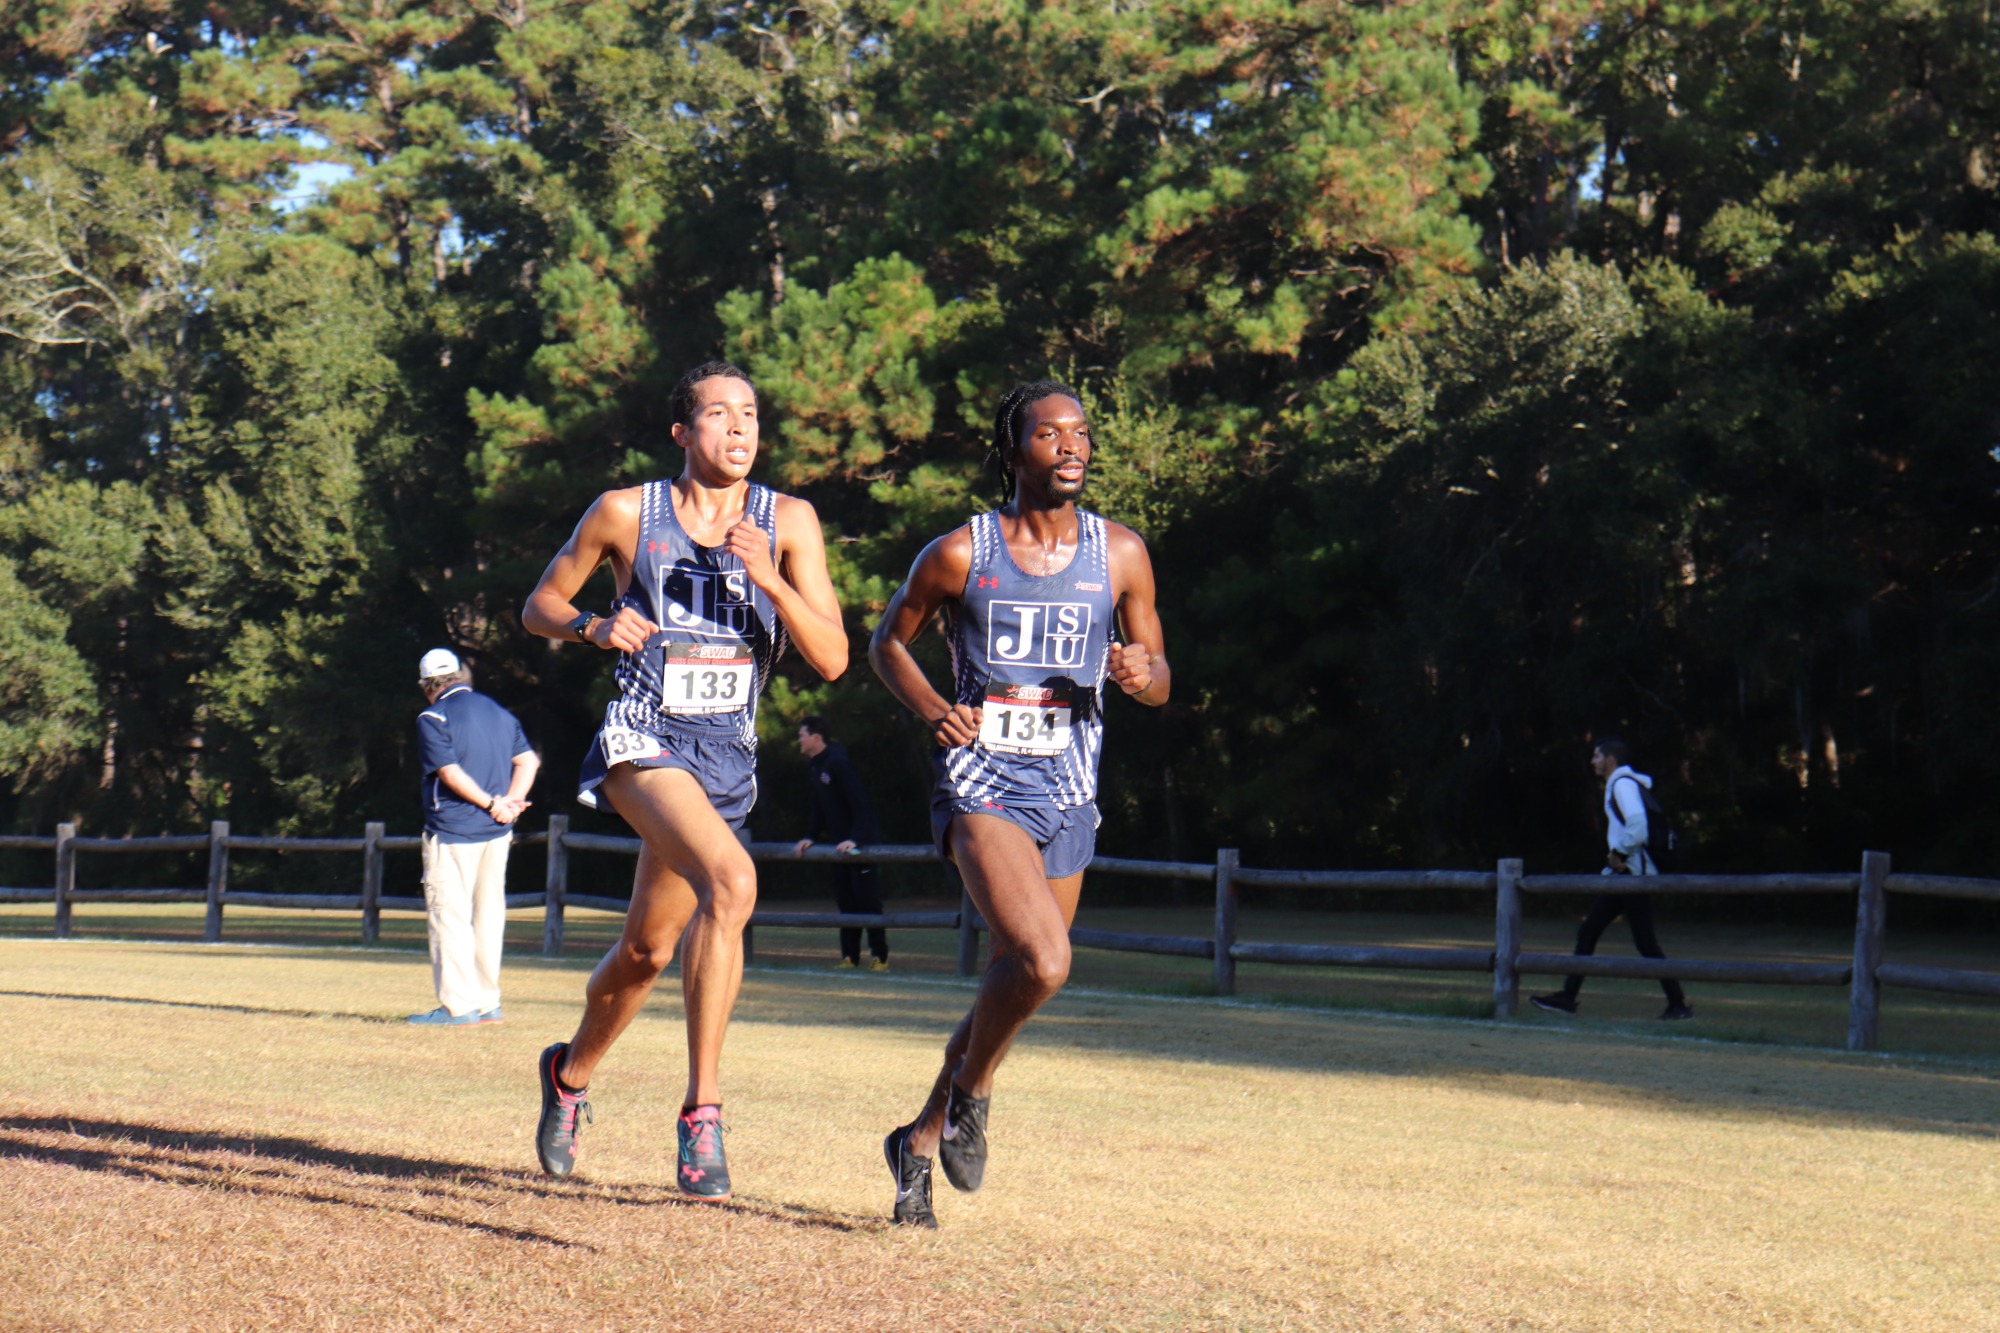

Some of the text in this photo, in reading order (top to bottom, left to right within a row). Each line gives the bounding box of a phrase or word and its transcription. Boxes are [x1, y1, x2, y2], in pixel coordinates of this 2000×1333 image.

[700, 646, 736, 658] SWAC
[681, 670, 738, 700] 133
[1018, 687, 1053, 700] SWAC
[1004, 697, 1029, 706] COUNTRY
[998, 710, 1055, 741] 134
